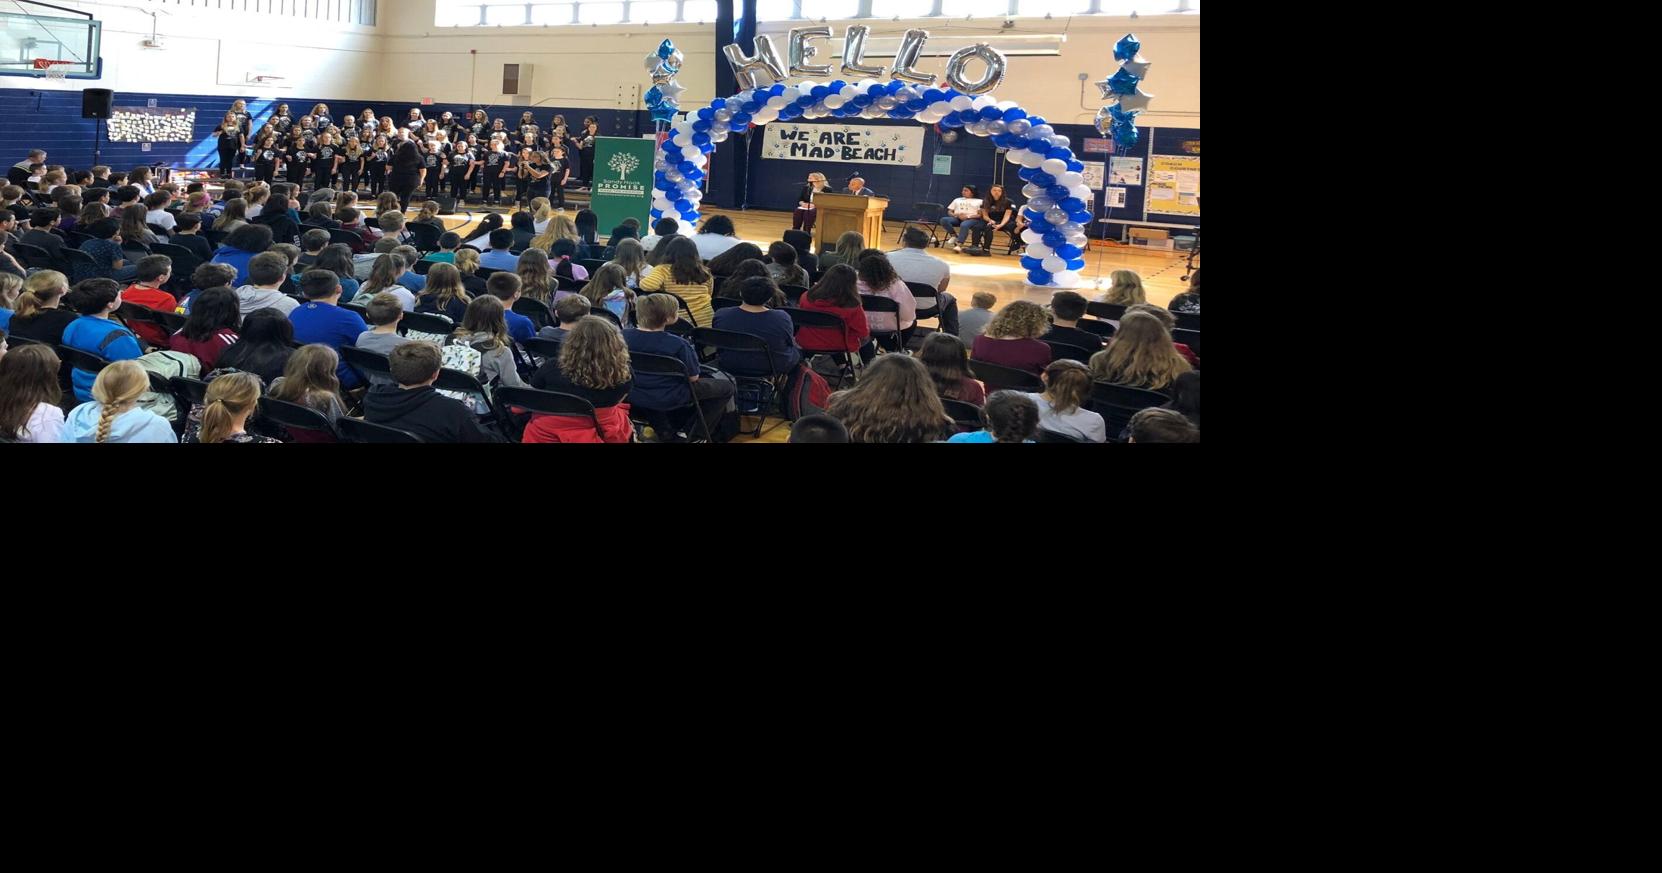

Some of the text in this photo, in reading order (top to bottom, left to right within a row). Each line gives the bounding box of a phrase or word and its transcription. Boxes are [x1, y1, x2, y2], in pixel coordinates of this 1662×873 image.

[723, 24, 1007, 95] HELLO
[780, 129, 861, 146] WE ARE
[790, 142, 897, 161] MAD BEACH
